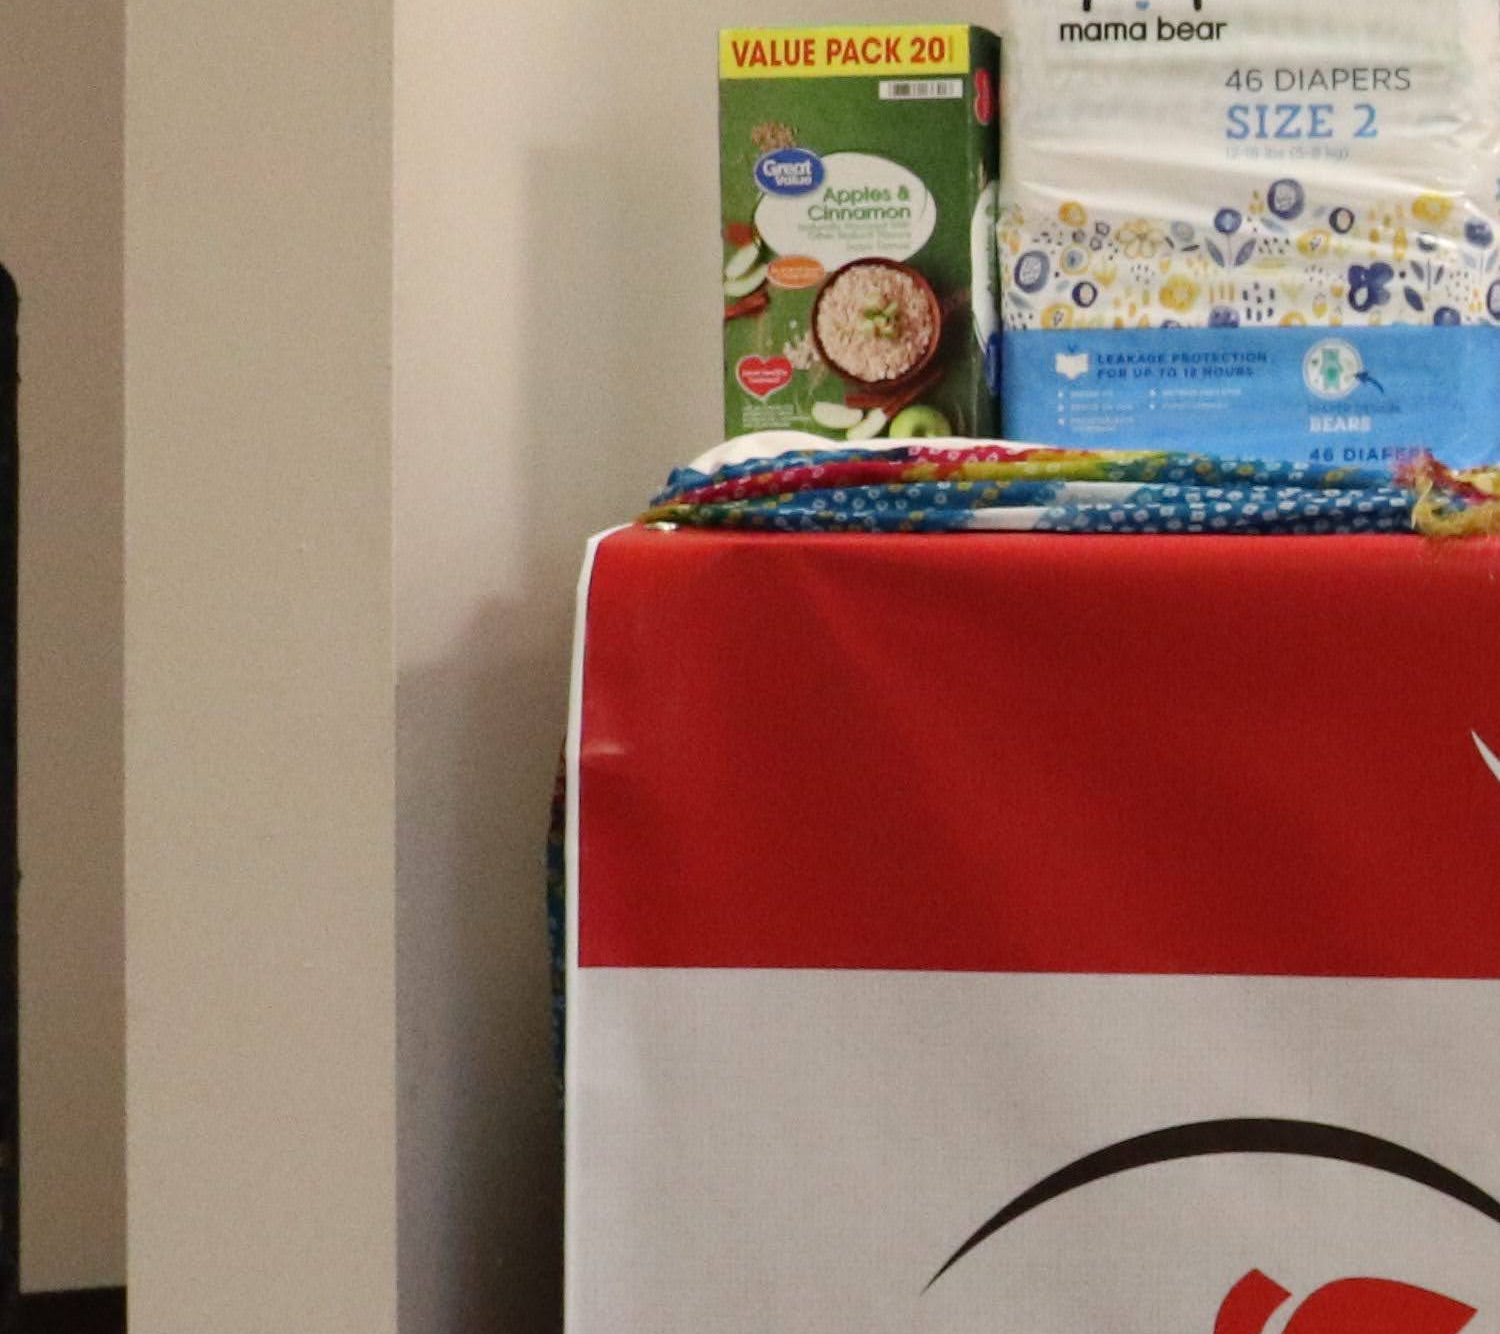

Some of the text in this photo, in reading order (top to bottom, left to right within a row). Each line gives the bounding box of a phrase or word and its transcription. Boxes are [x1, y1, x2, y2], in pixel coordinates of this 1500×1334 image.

[1059, 16, 1228, 42] mama bear
[732, 36, 946, 67] VALUE PACK 20
[1225, 67, 1411, 92] 46 DIAPERS
[1225, 102, 1379, 140] SIZE 2
[762, 158, 812, 178] Great
[774, 174, 813, 188] Value
[823, 186, 892, 206] Apples
[807, 205, 912, 221] Cinnamon
[1097, 351, 1269, 365] LEAKAGE PROTECTION
[1097, 366, 1128, 379] FOR
[1134, 366, 1153, 379] UP
[1159, 366, 1178, 378] TO
[1201, 366, 1254, 378] HOURS
[1308, 416, 1372, 433] BEARS
[1309, 447, 1335, 462] 46
